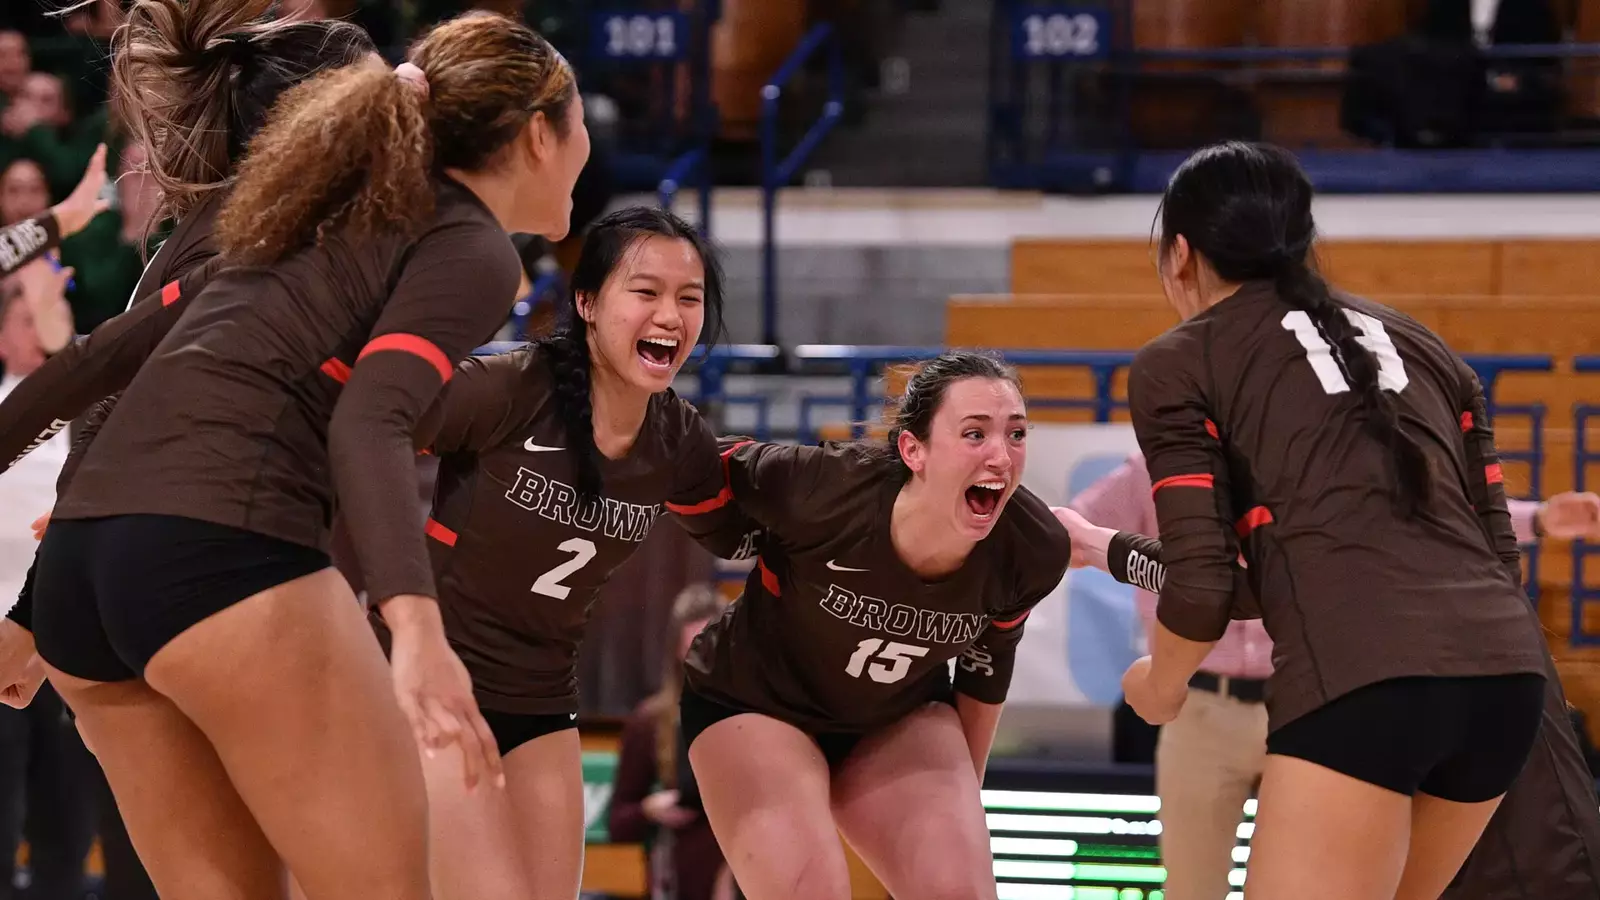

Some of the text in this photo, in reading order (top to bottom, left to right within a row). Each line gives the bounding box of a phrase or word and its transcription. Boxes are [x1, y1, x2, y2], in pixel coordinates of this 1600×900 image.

[604, 16, 677, 56] 101
[1021, 14, 1099, 56] 102
[505, 466, 661, 542] BROWN
[530, 537, 598, 601] 2
[819, 583, 988, 643] BROWN
[845, 637, 930, 684] 15
